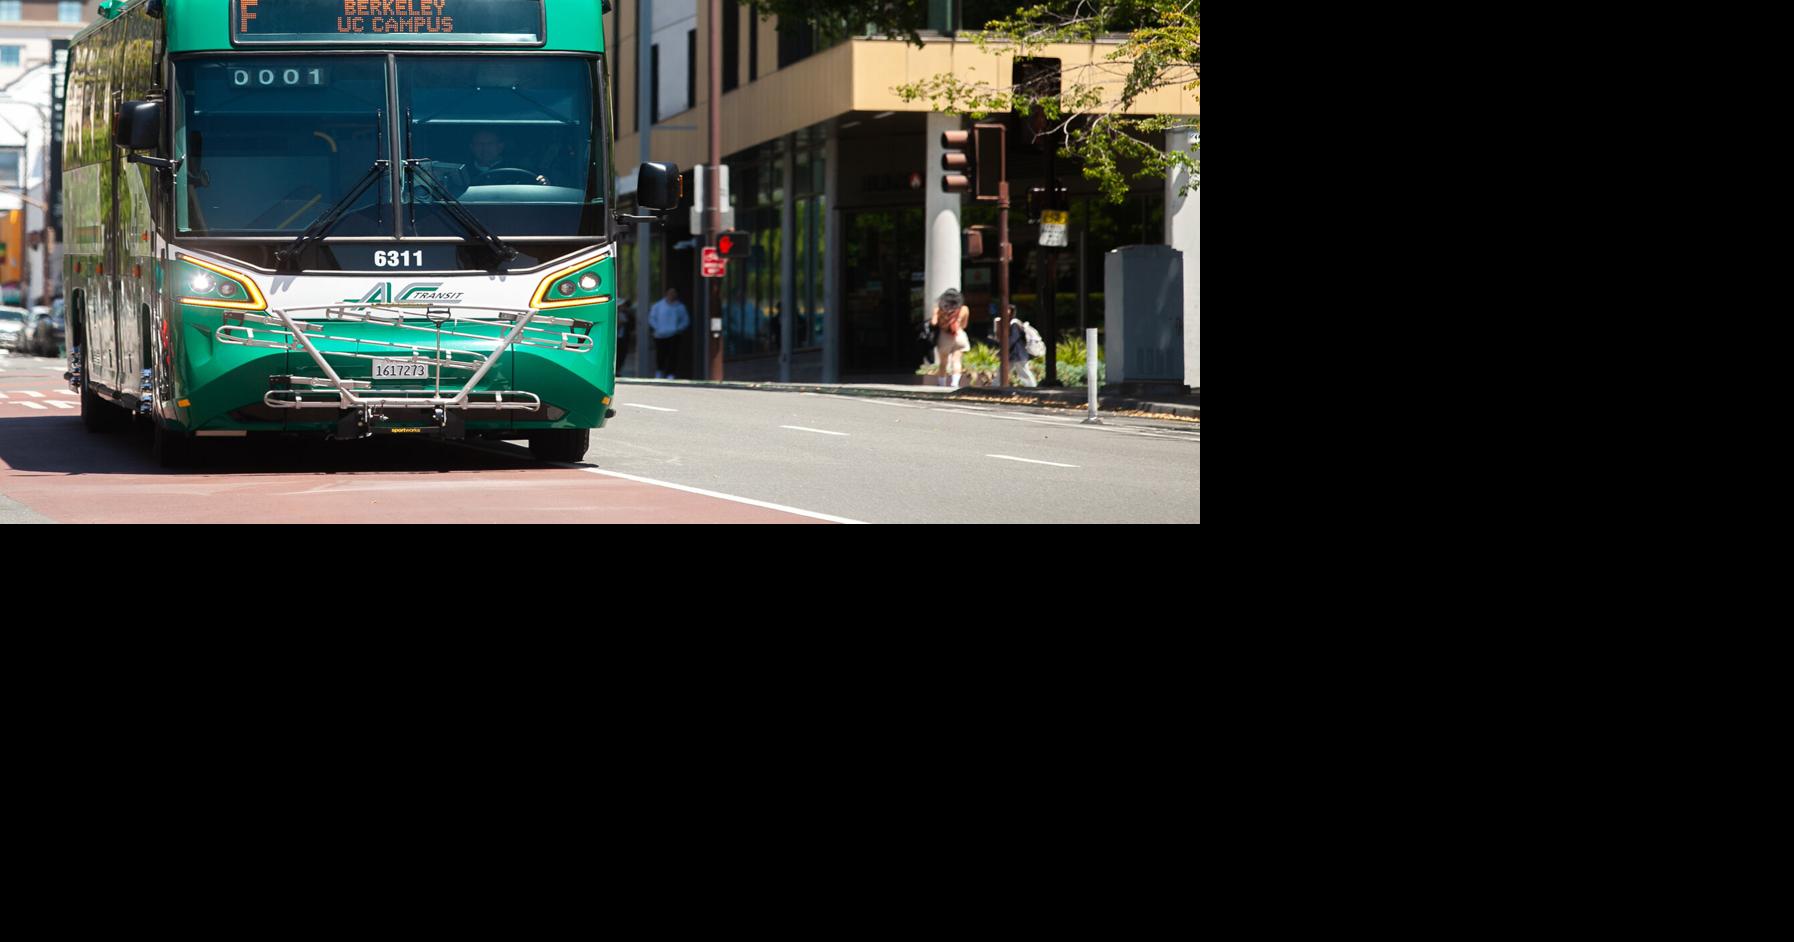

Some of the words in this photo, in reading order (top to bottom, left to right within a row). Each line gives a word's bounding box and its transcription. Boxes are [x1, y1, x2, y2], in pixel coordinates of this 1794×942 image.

[240, 0, 258, 33] F
[344, 0, 447, 16] BERKELEY
[337, 16, 364, 33] UC
[372, 16, 454, 33] CAMPUS
[233, 68, 320, 86] 0001
[374, 250, 423, 267] 6311
[413, 292, 464, 300] TRANSIT
[376, 364, 426, 377] 1617273
